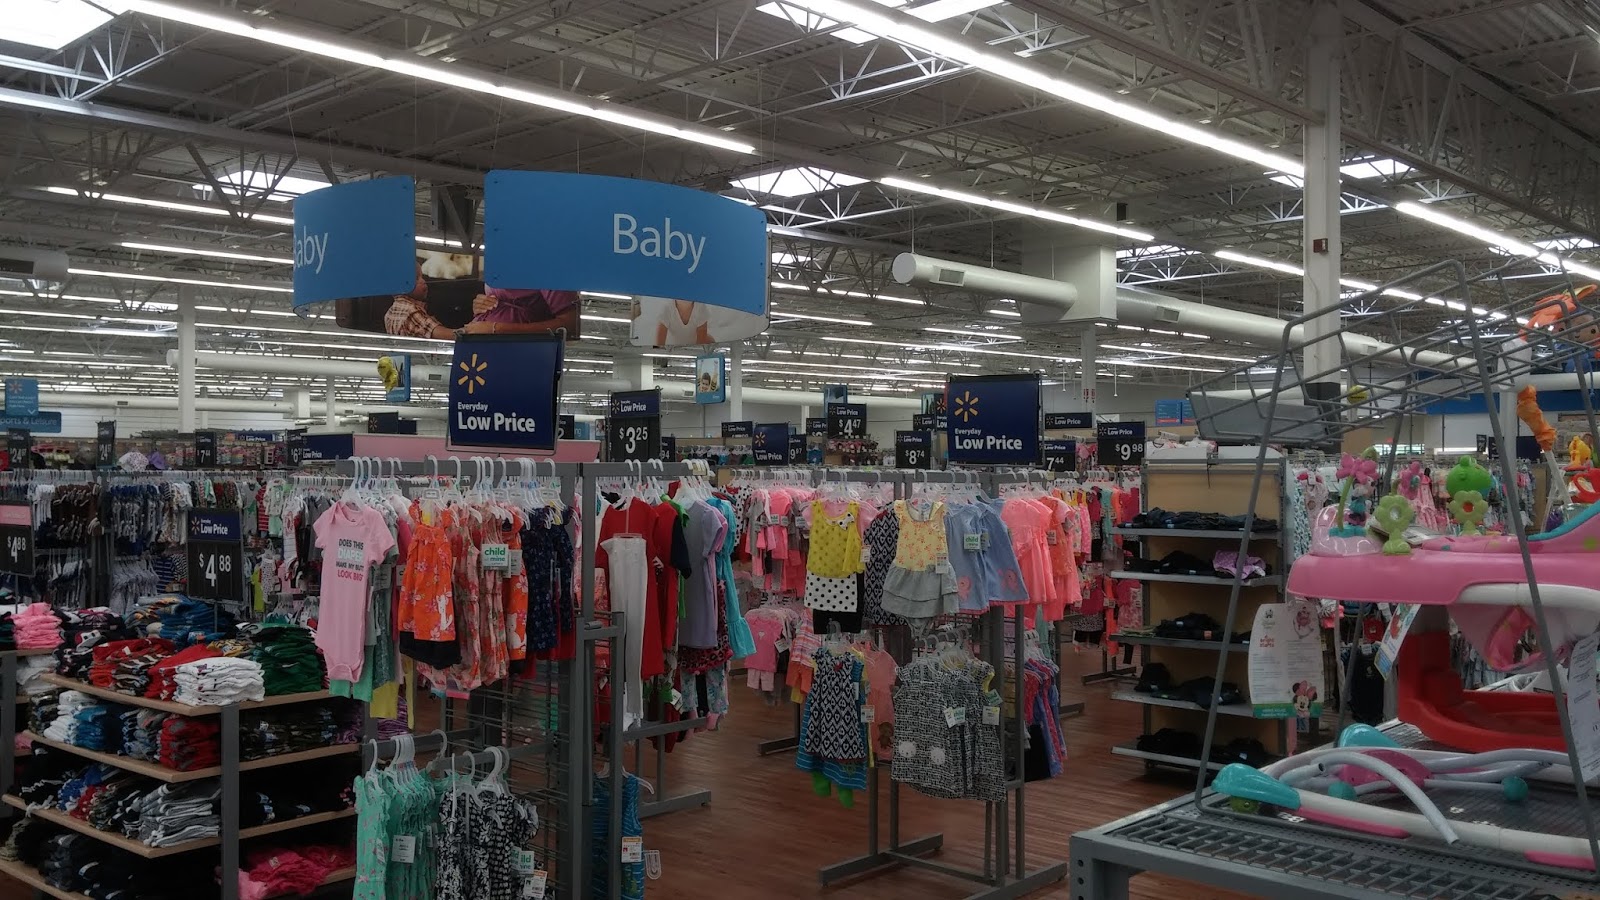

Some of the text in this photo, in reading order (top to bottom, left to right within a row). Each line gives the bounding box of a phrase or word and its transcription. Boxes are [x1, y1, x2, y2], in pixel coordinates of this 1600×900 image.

[613, 213, 706, 274] Baby
[293, 225, 328, 275] aby
[457, 402, 488, 412] Everyday
[621, 402, 647, 412] Low Price
[458, 412, 536, 432] Low Price
[955, 428, 981, 436] Everyday
[619, 427, 648, 454] $325
[955, 435, 1022, 450] Low Price
[201, 523, 228, 535] Low Price
[339, 539, 364, 550] DOES THIS
[484, 547, 506, 555] child
[199, 553, 231, 587] $488
[337, 570, 352, 579] LOOK
